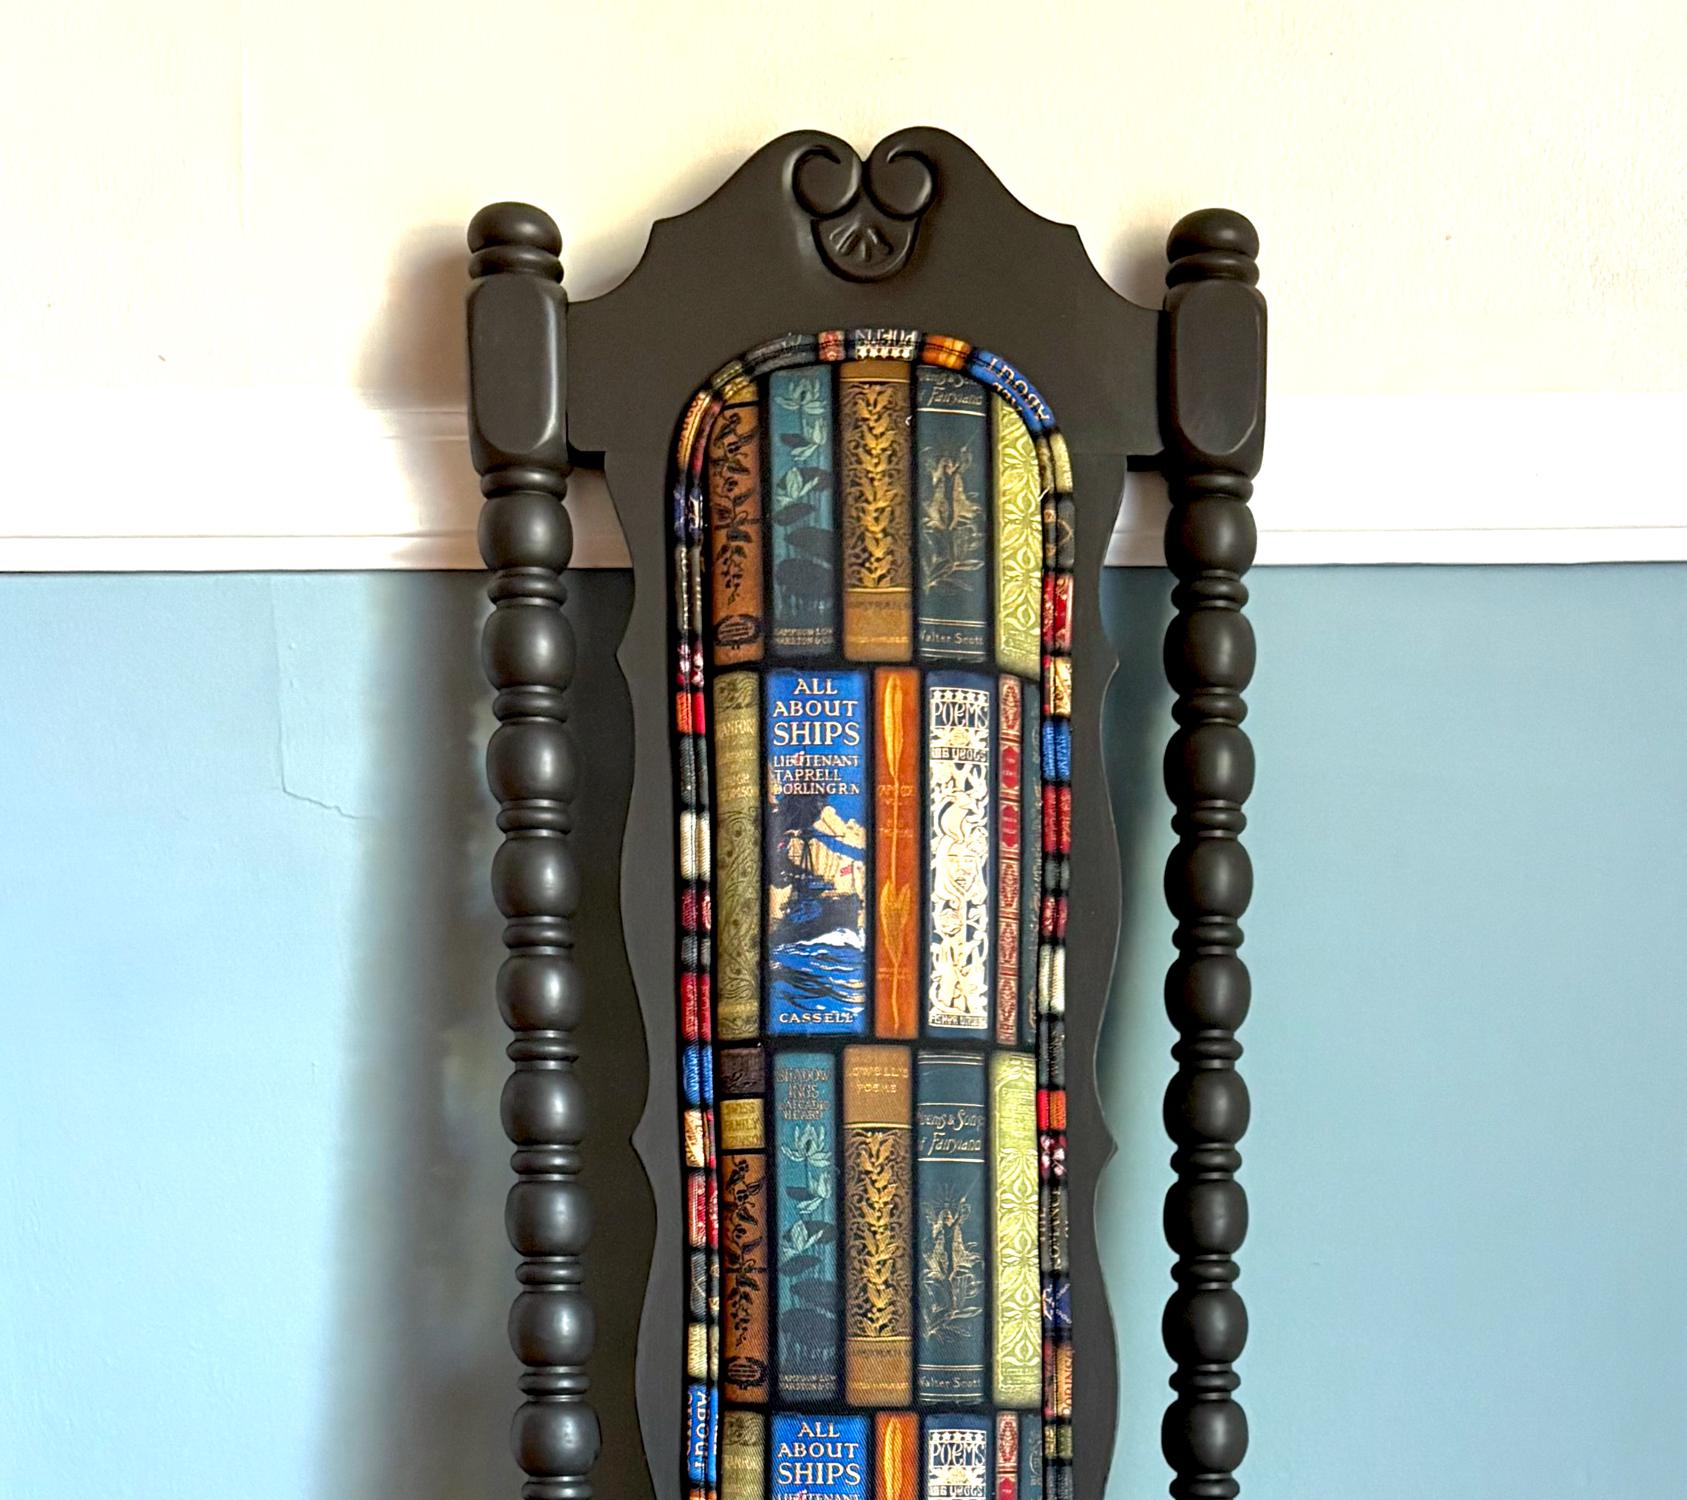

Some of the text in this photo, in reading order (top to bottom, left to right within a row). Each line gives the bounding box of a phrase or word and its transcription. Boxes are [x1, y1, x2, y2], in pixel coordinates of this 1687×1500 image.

[793, 678, 838, 695] ALL
[773, 701, 858, 717] ABOUT
[773, 721, 860, 746] SHIPS
[774, 754, 859, 767] LIEUTENANT
[774, 769, 842, 781] TAPRELL
[773, 783, 836, 795] DORLING
[779, 1011, 855, 1024] CASSELL
[797, 1421, 840, 1438] ALL
[778, 1442, 859, 1458] ABOUT
[778, 1463, 861, 1486] SHIPS
